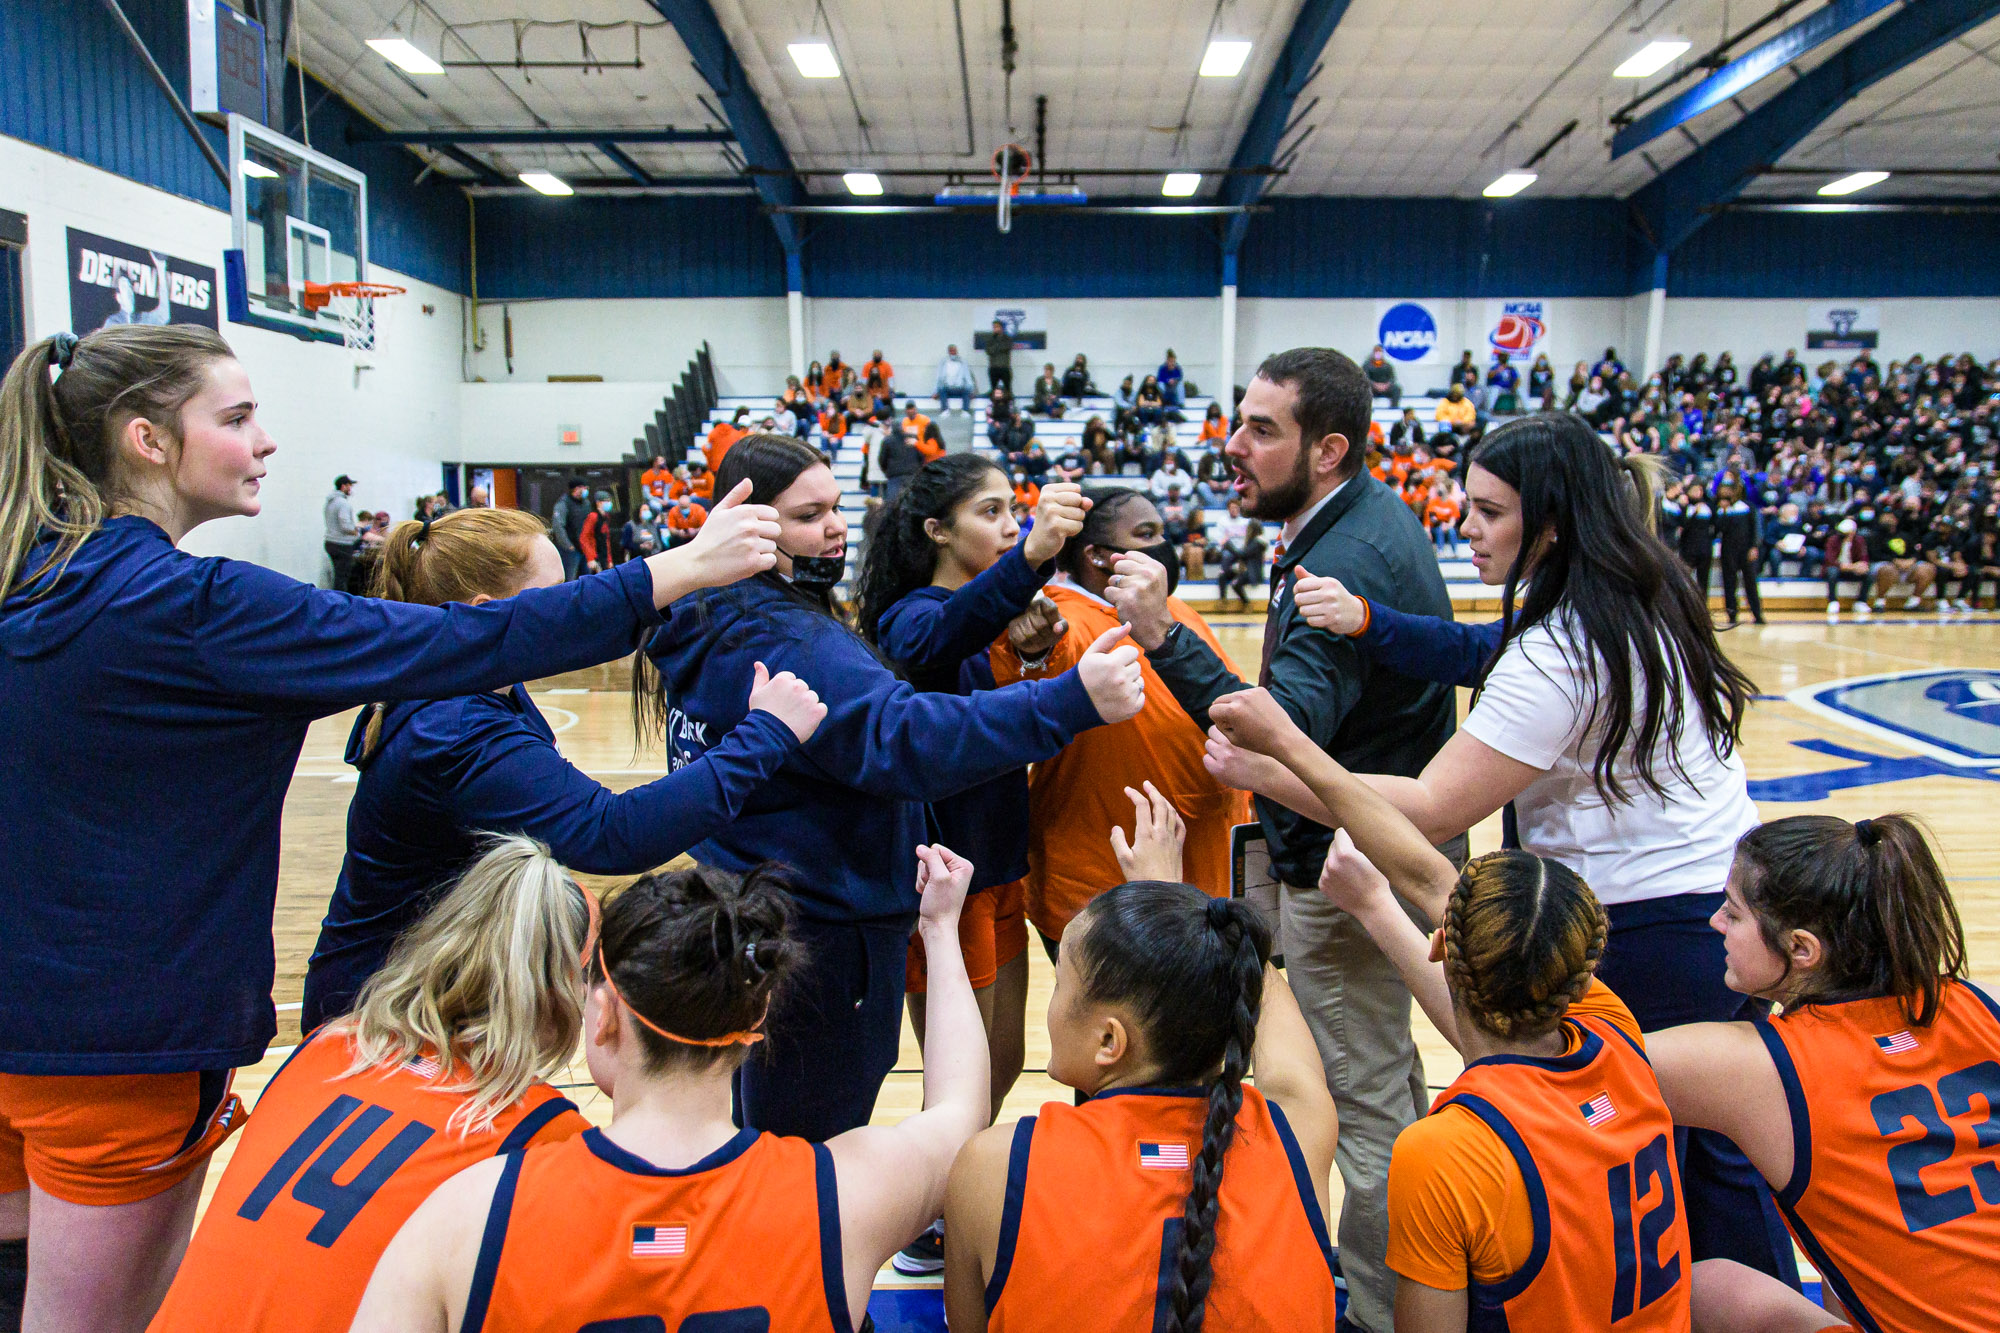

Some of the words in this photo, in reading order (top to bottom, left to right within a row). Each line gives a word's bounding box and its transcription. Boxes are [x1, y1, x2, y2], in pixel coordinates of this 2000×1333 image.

[79, 248, 211, 311] DEFENERS
[1384, 330, 1437, 349] NCAA
[236, 1093, 436, 1248] 14
[1870, 1060, 2000, 1233] 23
[1607, 1133, 1681, 1325] 12
